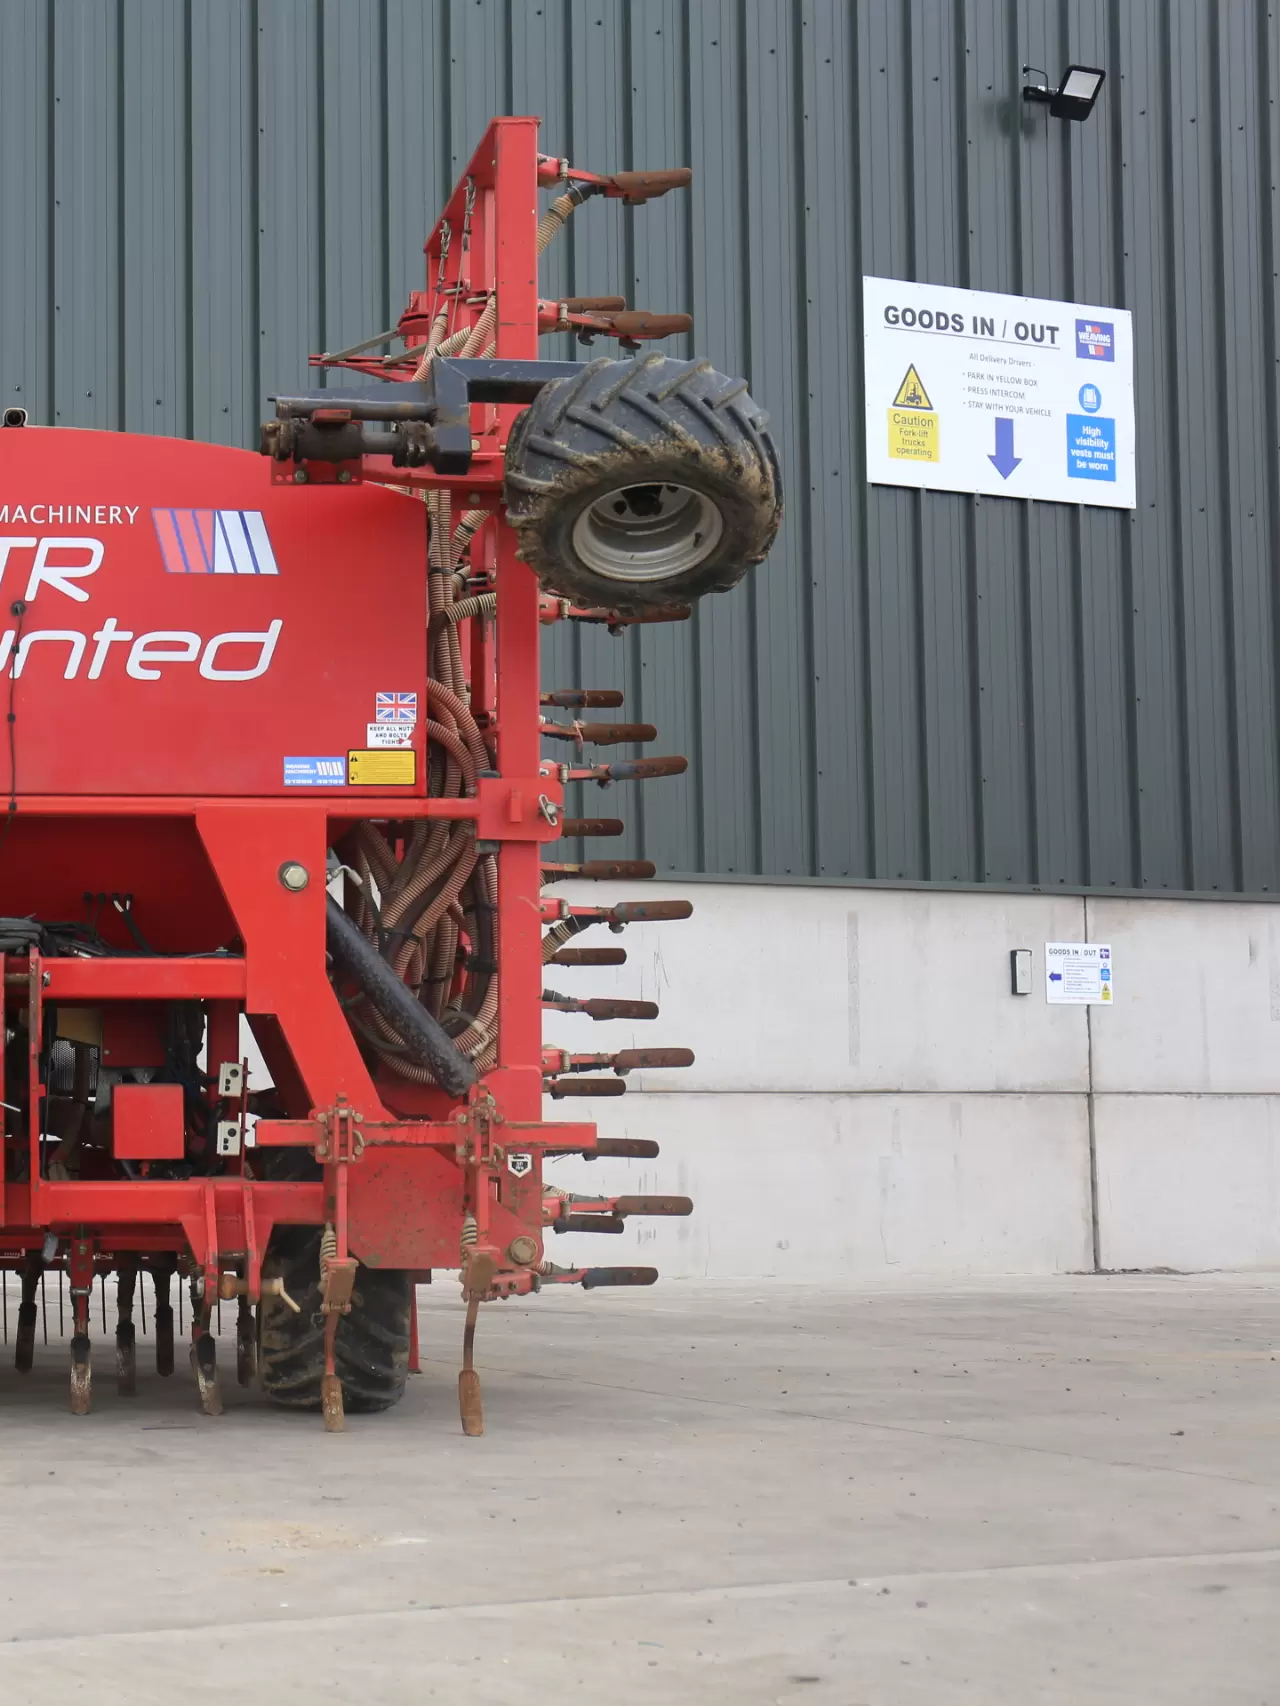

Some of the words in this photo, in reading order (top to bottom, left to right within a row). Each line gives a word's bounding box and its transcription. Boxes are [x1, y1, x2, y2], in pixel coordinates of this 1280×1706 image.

[884, 305, 964, 333] GOODS
[972, 316, 995, 336] IN
[1002, 319, 1008, 339] /
[1014, 321, 1060, 344] OUT
[1078, 331, 1111, 343] WEAVING
[969, 352, 979, 361] All
[980, 354, 1007, 366] Delivery
[1008, 357, 1032, 368] Drivers
[967, 371, 985, 381] PARK
[986, 373, 994, 382] IN
[995, 375, 1023, 385] YELLOW
[1023, 378, 1038, 387] BOX
[967, 386, 989, 396] PRESS
[989, 388, 1025, 400] INTERCOM
[968, 400, 984, 409] STAY
[985, 402, 1004, 411] WITH
[1005, 404, 1024, 414] YOUR
[1025, 407, 1052, 417] VEHICLE
[893, 413, 934, 428] Caution
[899, 427, 929, 439] Fork-lift
[1082, 425, 1102, 438] High
[902, 438, 926, 447] trucks
[1075, 436, 1109, 451] visibility
[896, 447, 932, 459] operating
[1070, 448, 1093, 458] vests
[1093, 451, 1115, 461] must
[1076, 459, 1087, 469] be
[1088, 462, 1109, 471] worn
[1048, 947, 1071, 956] GOODS
